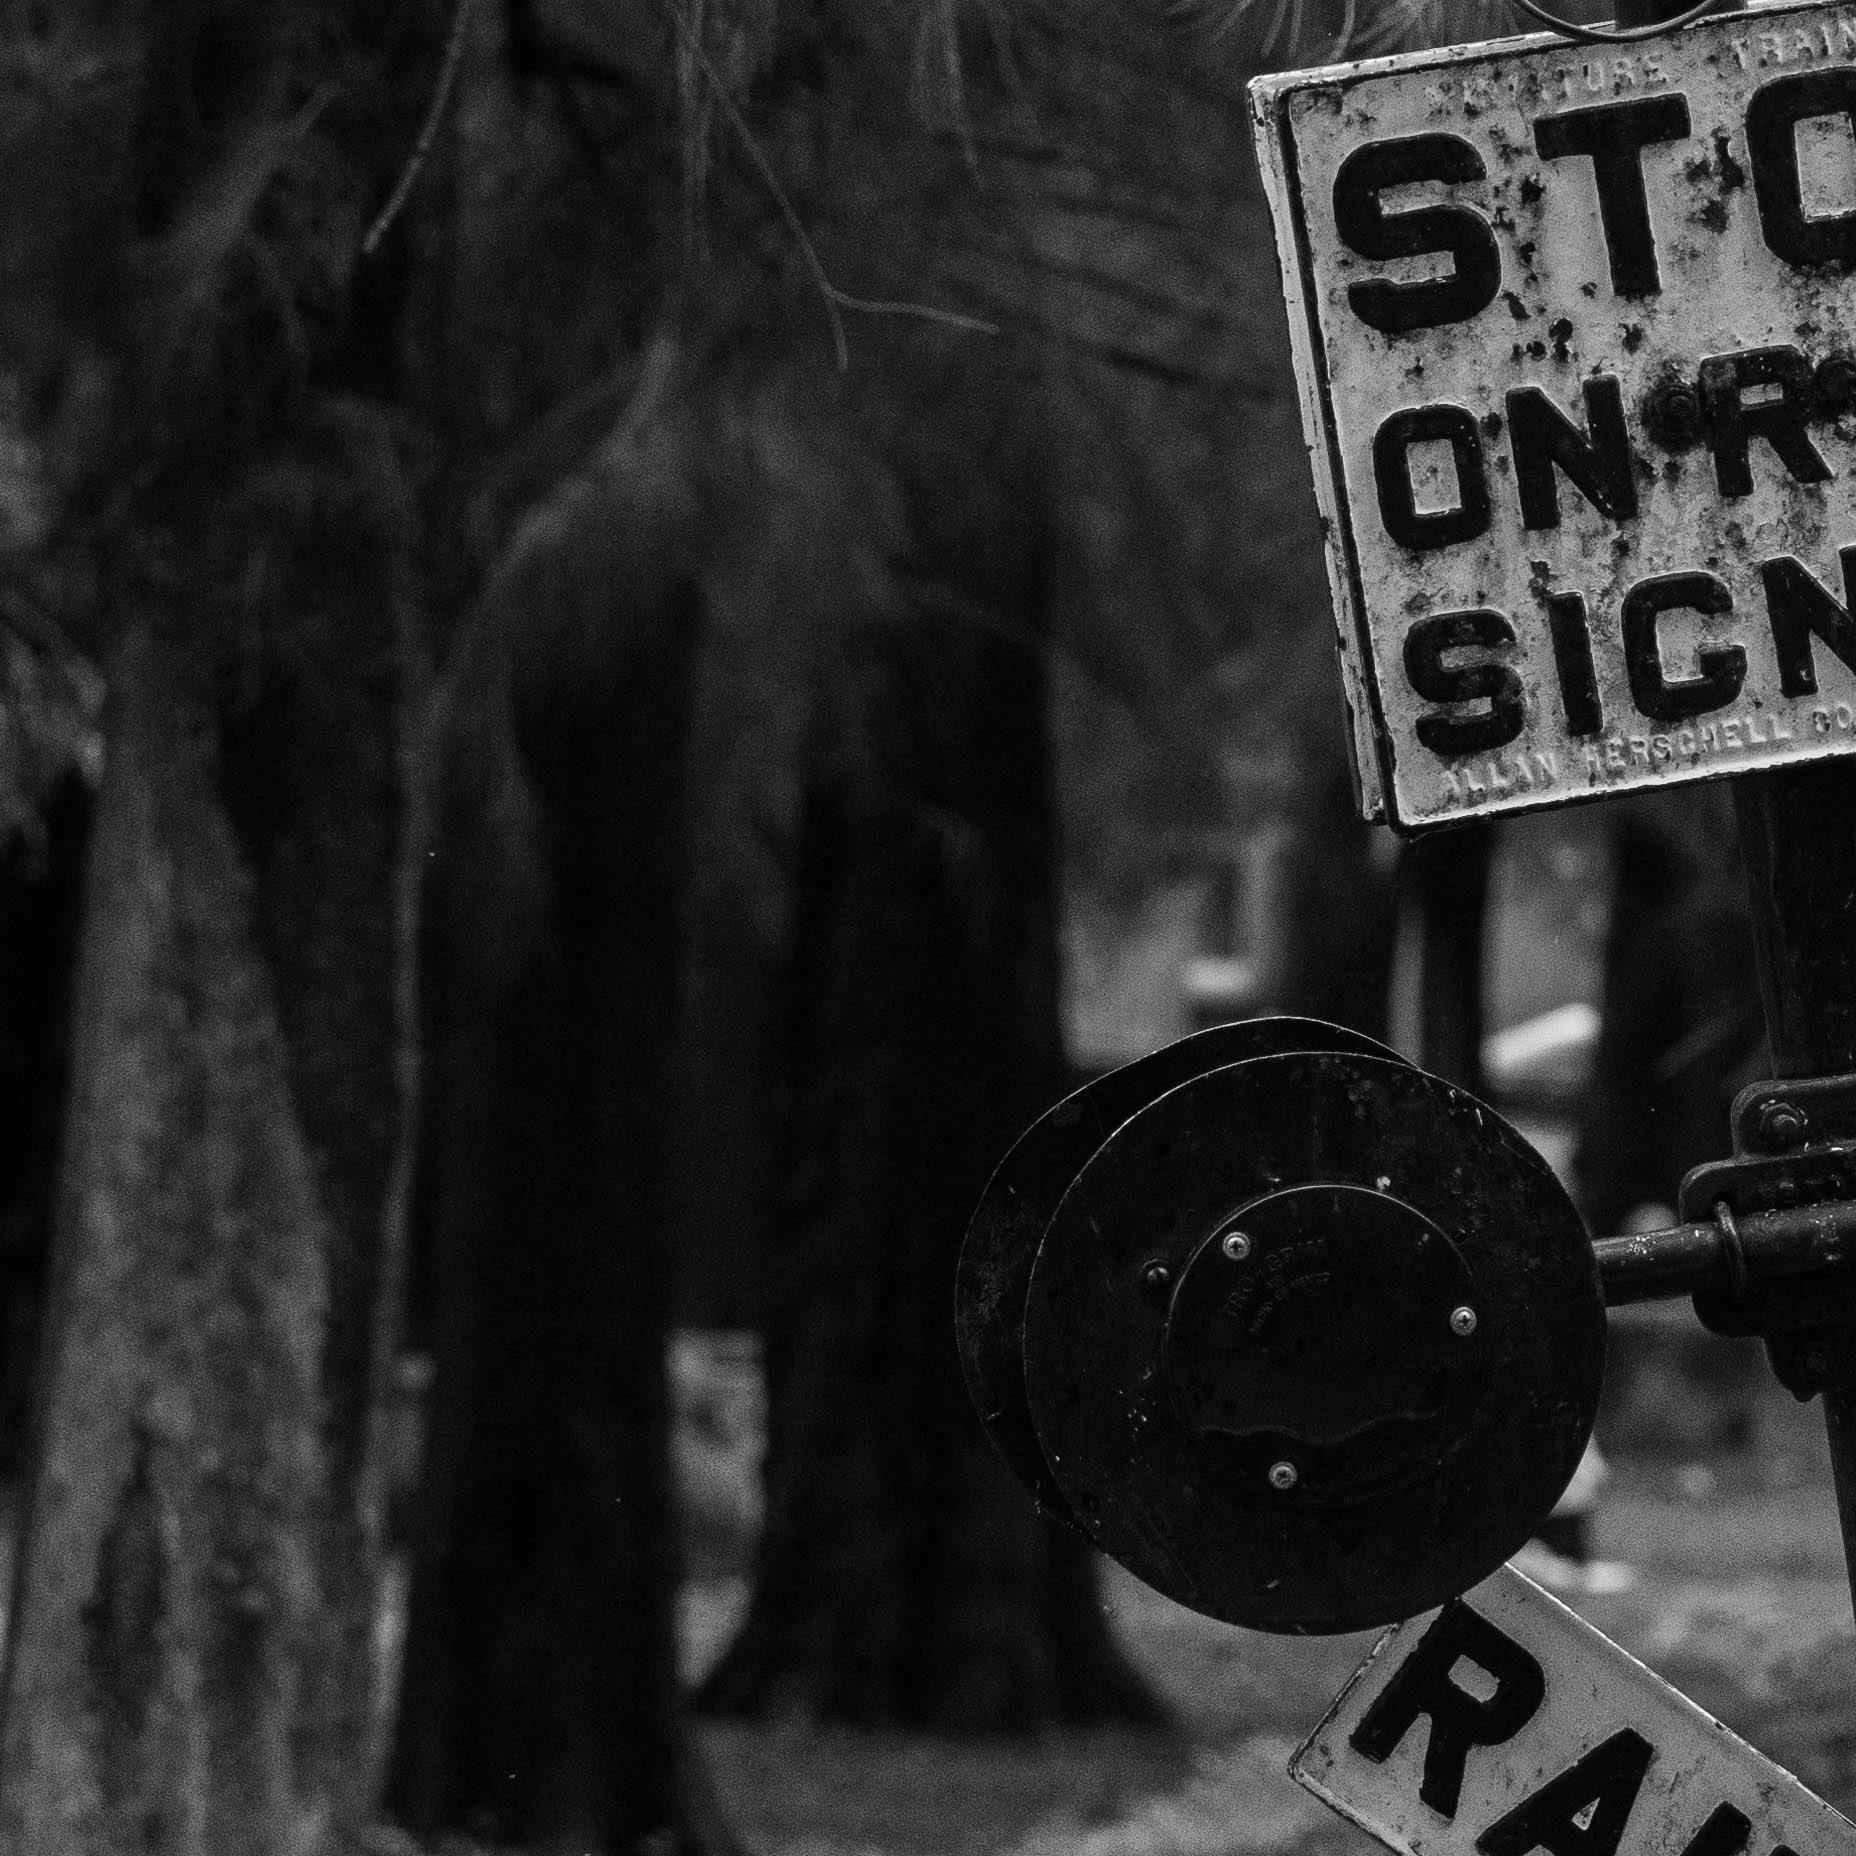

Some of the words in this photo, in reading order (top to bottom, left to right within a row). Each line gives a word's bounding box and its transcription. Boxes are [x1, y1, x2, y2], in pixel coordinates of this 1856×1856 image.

[1372, 372, 1638, 548] ON
[1440, 750, 1560, 796] ALLAN
[1584, 714, 1794, 768] HERSCHELL
